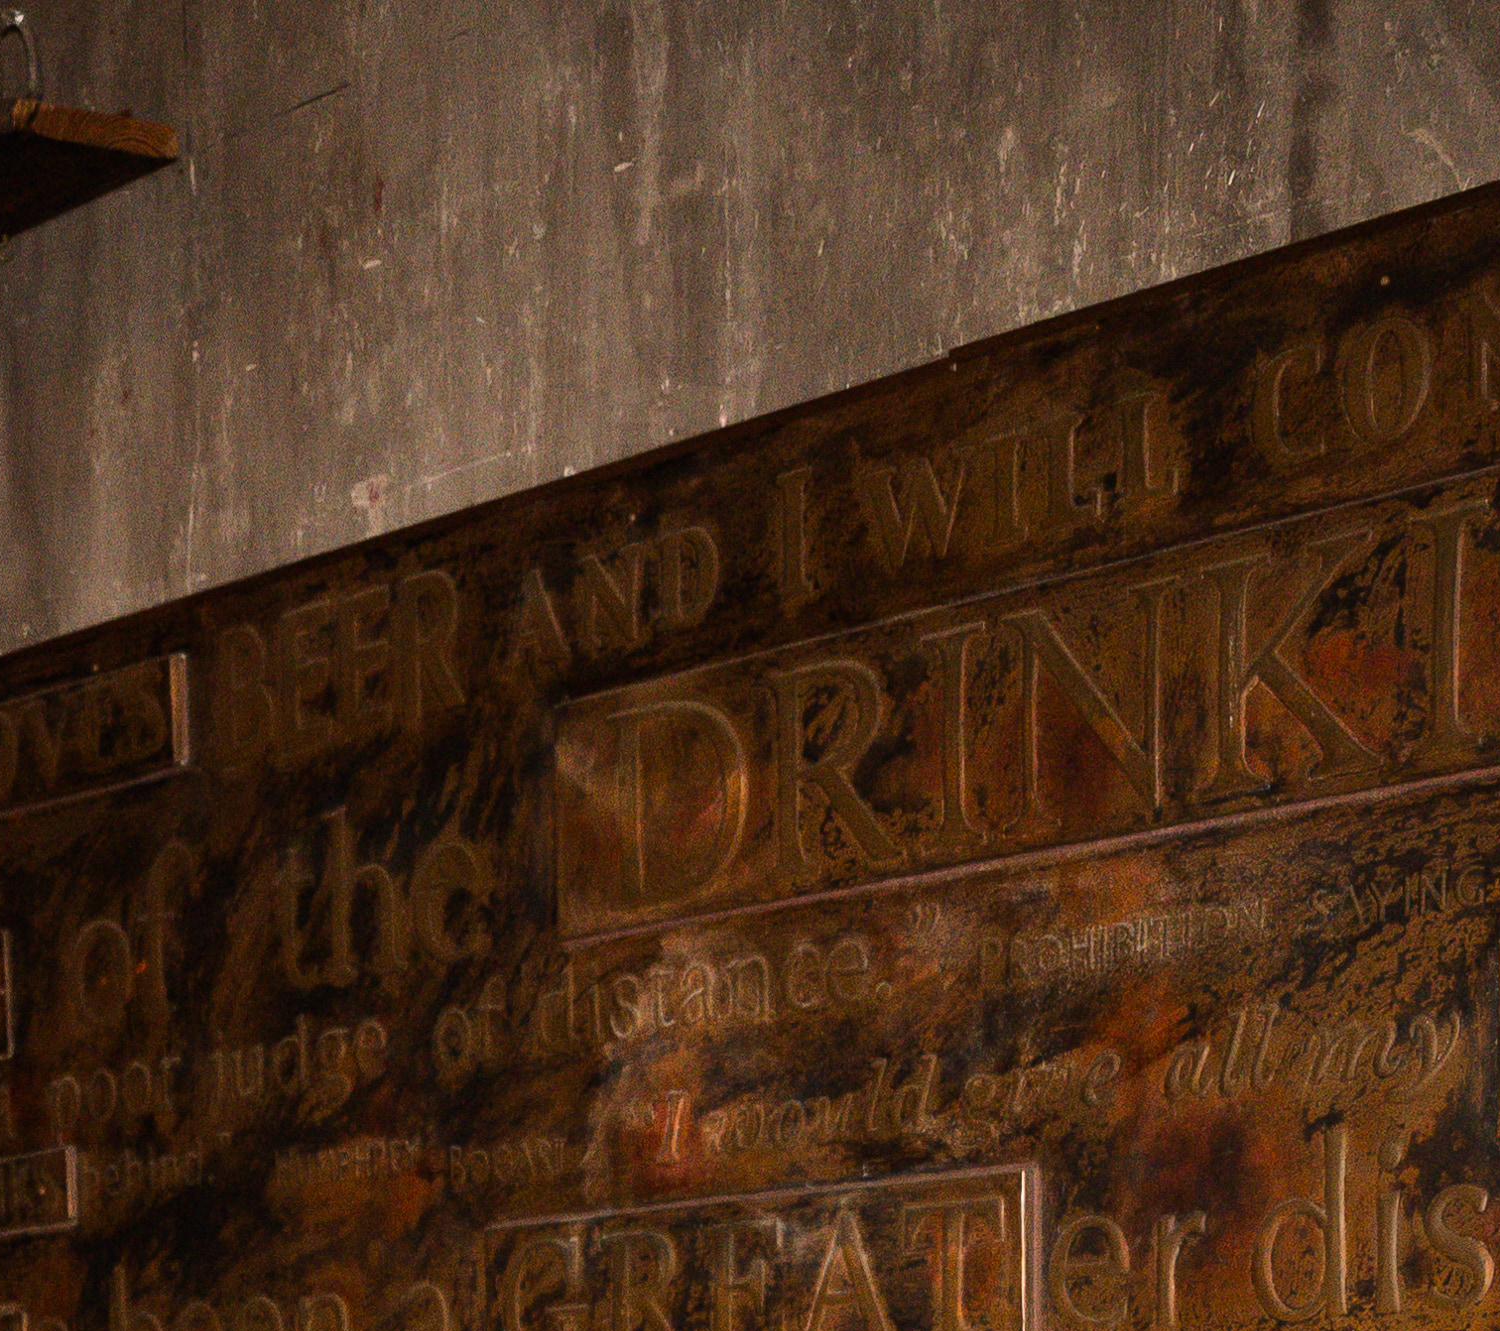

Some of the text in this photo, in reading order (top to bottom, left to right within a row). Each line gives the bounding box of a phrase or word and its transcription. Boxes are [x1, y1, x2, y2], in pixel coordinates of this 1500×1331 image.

[205, 568, 468, 785] BEER
[498, 518, 728, 685] AND
[858, 385, 1190, 572] WILL
[265, 805, 500, 992] the
[1305, 865, 1490, 935] SAYING
[208, 1010, 392, 1125] judge
[1165, 1000, 1285, 1100] all
[1305, 1008, 1465, 1100] my
